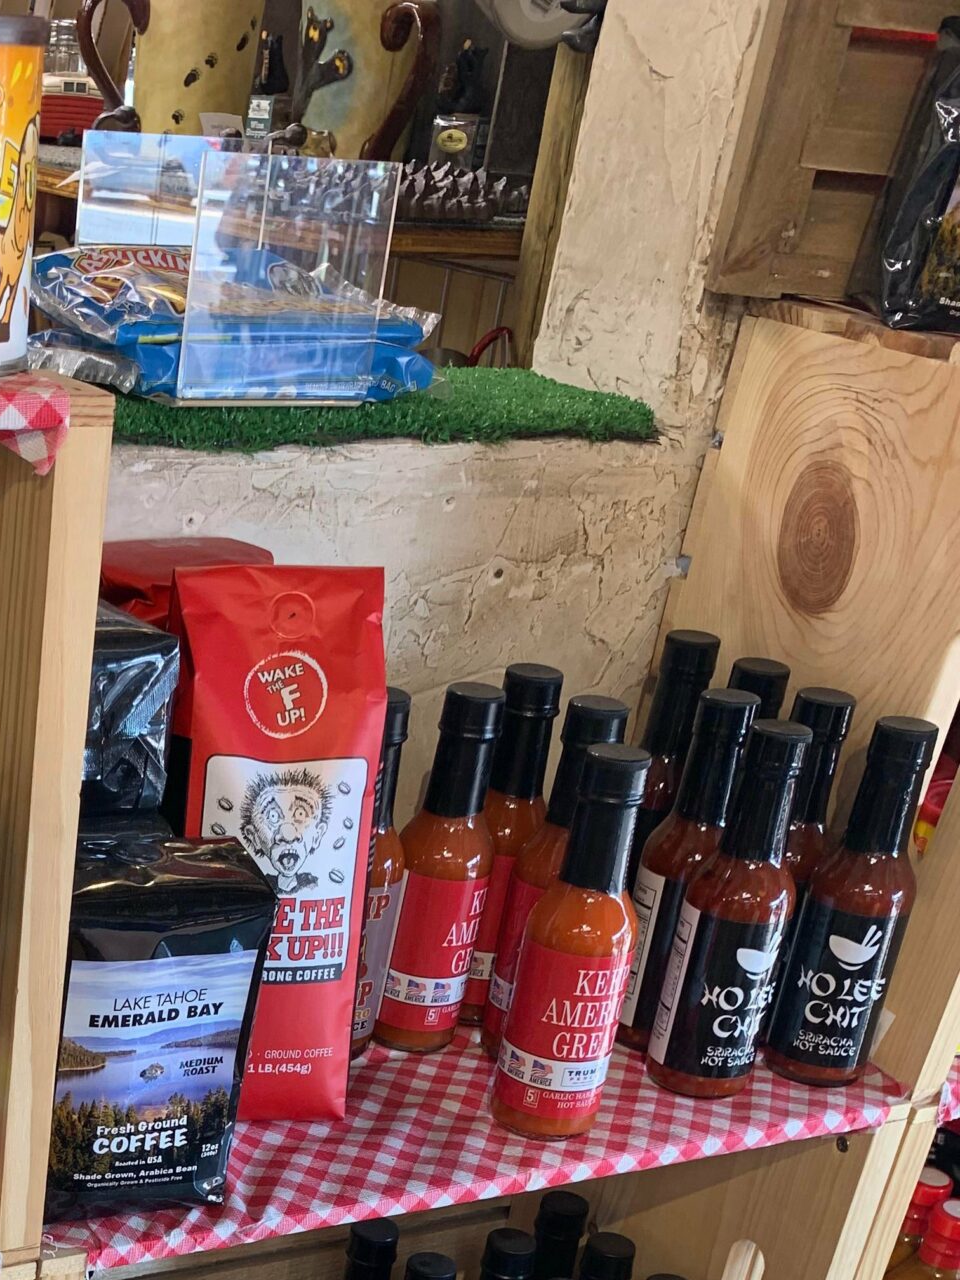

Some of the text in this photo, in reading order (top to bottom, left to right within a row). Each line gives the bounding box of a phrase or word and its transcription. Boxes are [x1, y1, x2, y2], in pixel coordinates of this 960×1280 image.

[258, 663, 304, 684] WAKE
[267, 680, 284, 695] THE
[281, 684, 301, 710] F
[277, 710, 306, 727] UP!
[300, 897, 345, 931] THE
[296, 968, 335, 981] COFFEE
[797, 964, 886, 1001] HO LEE
[113, 988, 208, 1012] LAKE TAHOE
[701, 982, 742, 1010] HO
[89, 1002, 224, 1029] EMERALD BAY
[804, 1000, 868, 1028] CHIT
[793, 1039, 856, 1058] HOT SAUCE
[798, 1030, 854, 1047] SRIRACHA
[179, 1056, 224, 1070] MEDIUM
[264, 1048, 333, 1059] GROUND COFFEE
[700, 1056, 724, 1068] HOT
[183, 1065, 218, 1077] ROAST
[96, 1115, 188, 1136] Fresh Ground
[93, 1128, 188, 1155] COFFEE
[139, 1167, 174, 1177] Arabica
